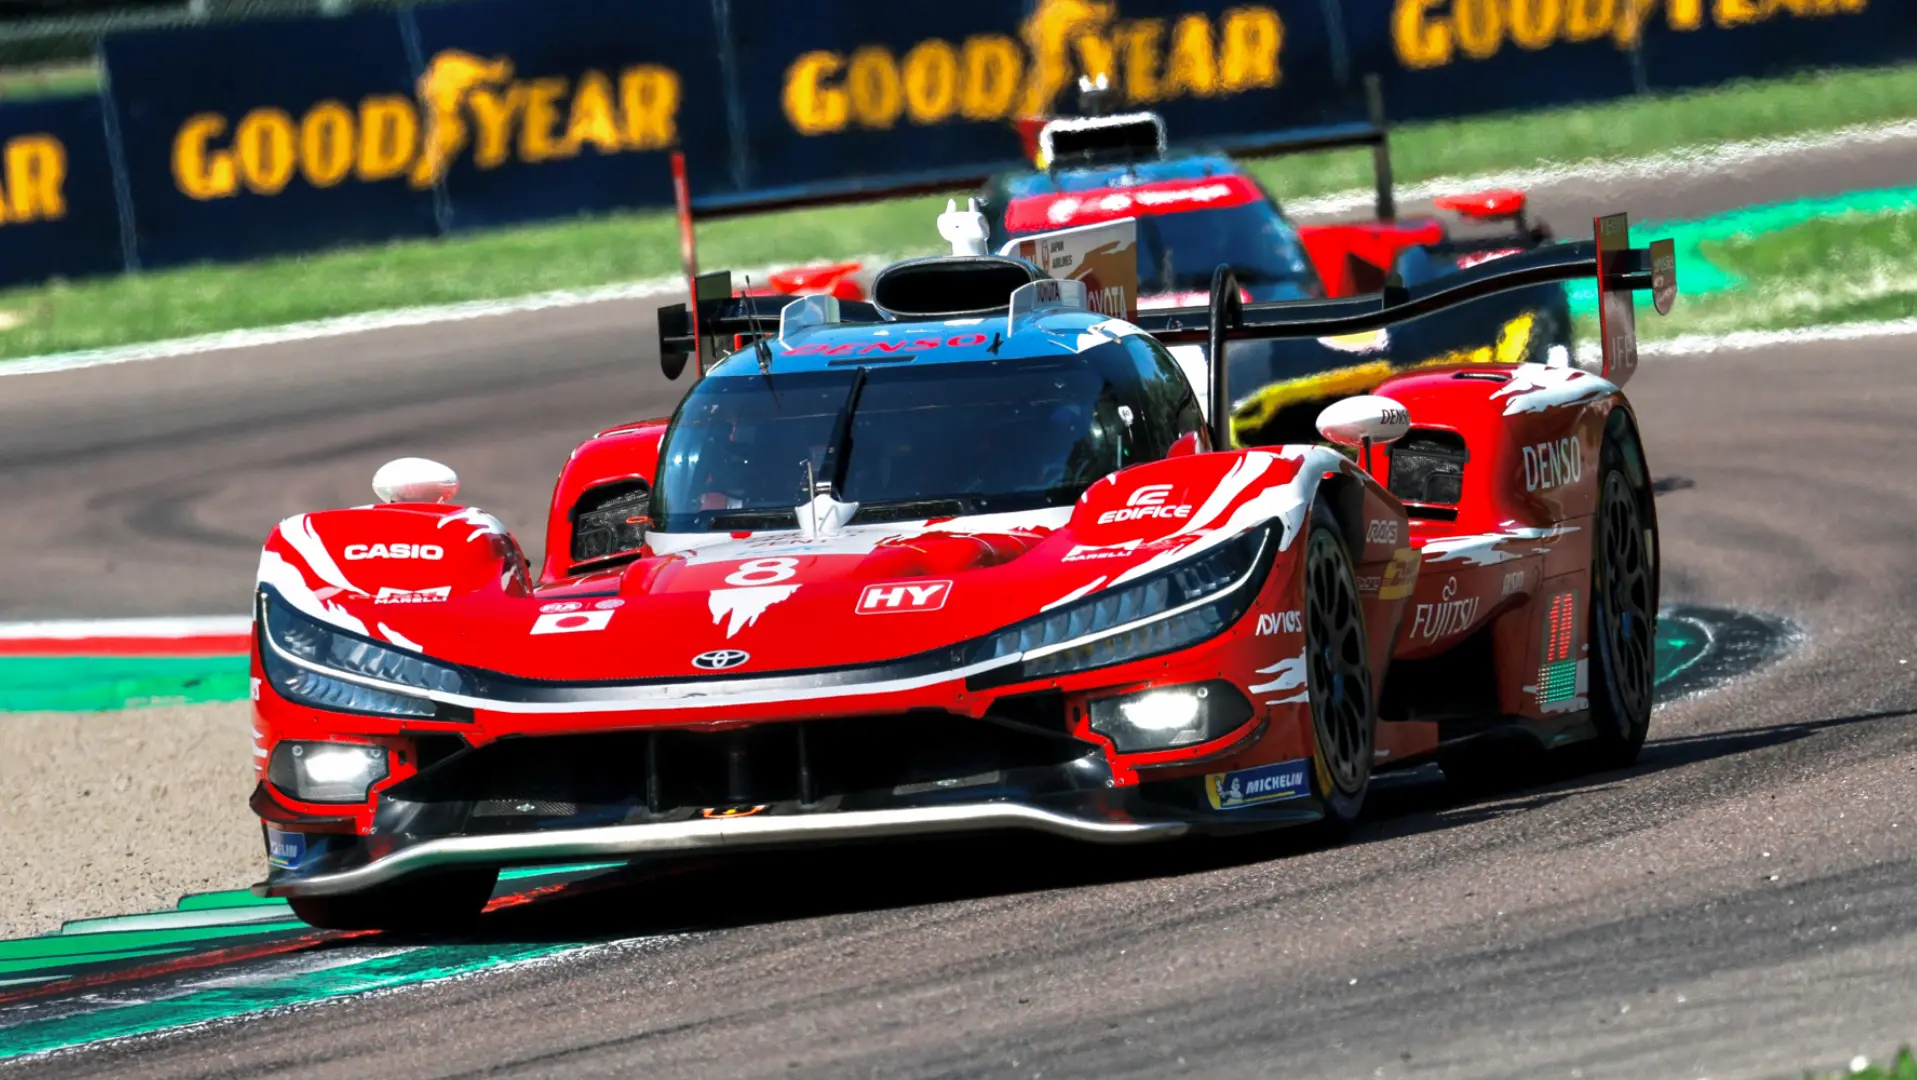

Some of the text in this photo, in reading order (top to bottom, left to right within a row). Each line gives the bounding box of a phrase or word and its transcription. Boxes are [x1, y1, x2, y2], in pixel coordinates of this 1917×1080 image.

[0, 133, 66, 223] R
[1087, 285, 1128, 320] OYOTA
[780, 333, 988, 356] DENSO
[1611, 335, 1634, 370] JFE
[1523, 435, 1582, 492] DENSO
[1098, 504, 1193, 524] EDIFICE
[344, 543, 444, 561] CASIO
[724, 557, 799, 587] 8
[864, 585, 941, 608] HY
[1255, 610, 1303, 636] ADVICS
[1409, 596, 1479, 644] FUJITSU
[1246, 771, 1304, 795] MICHELIN
